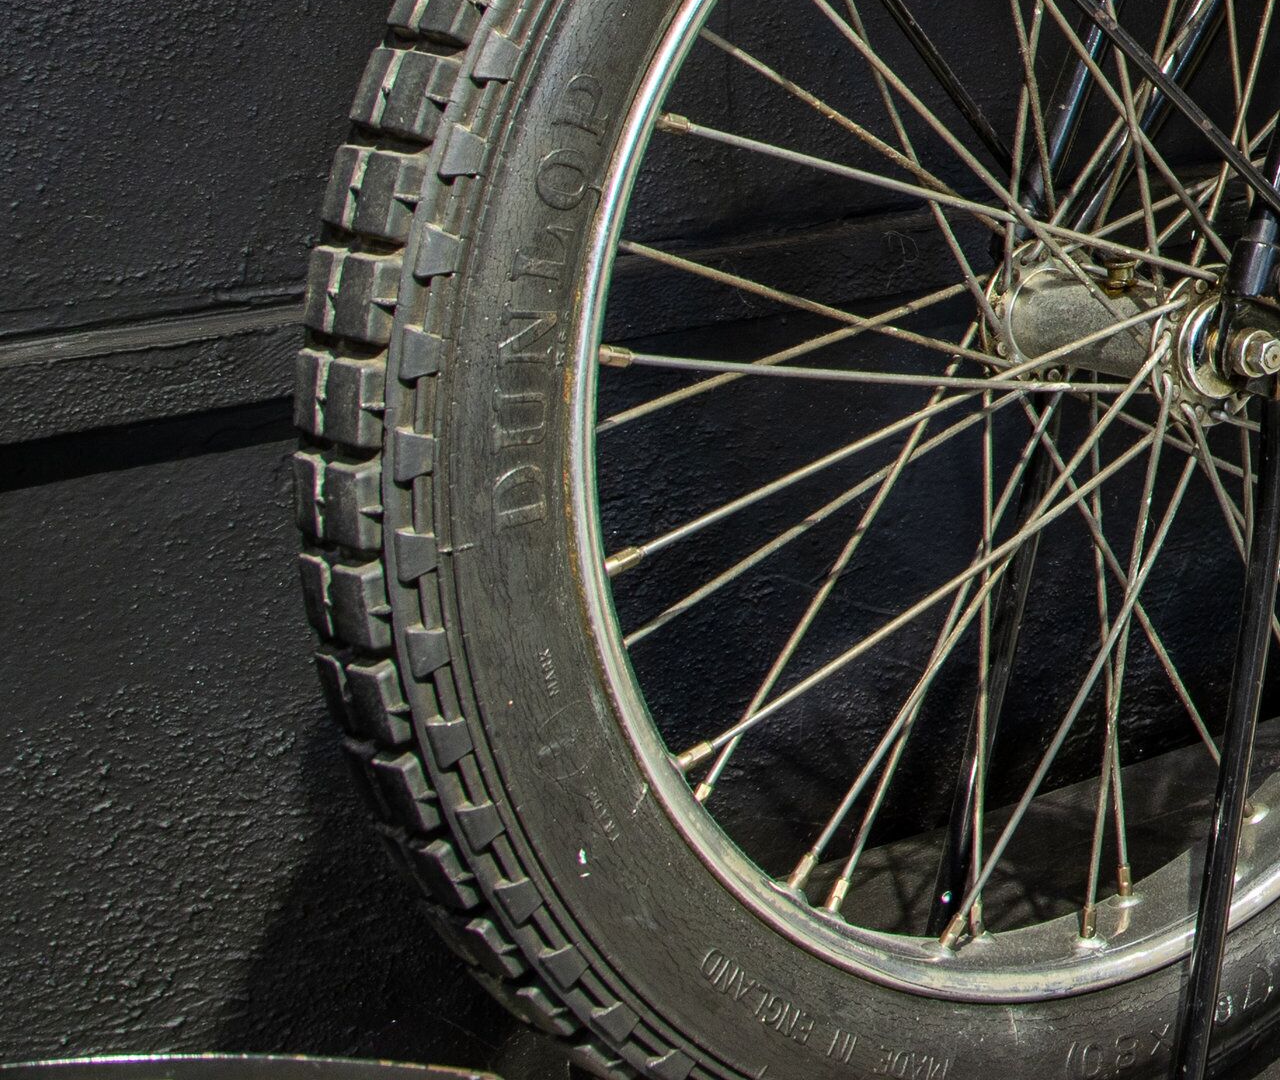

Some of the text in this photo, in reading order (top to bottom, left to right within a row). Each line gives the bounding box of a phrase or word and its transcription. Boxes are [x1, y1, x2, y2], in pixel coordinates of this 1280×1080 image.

[492, 71, 604, 530] DUNLOP
[701, 947, 950, 1078] MADE IN ENGLAND
